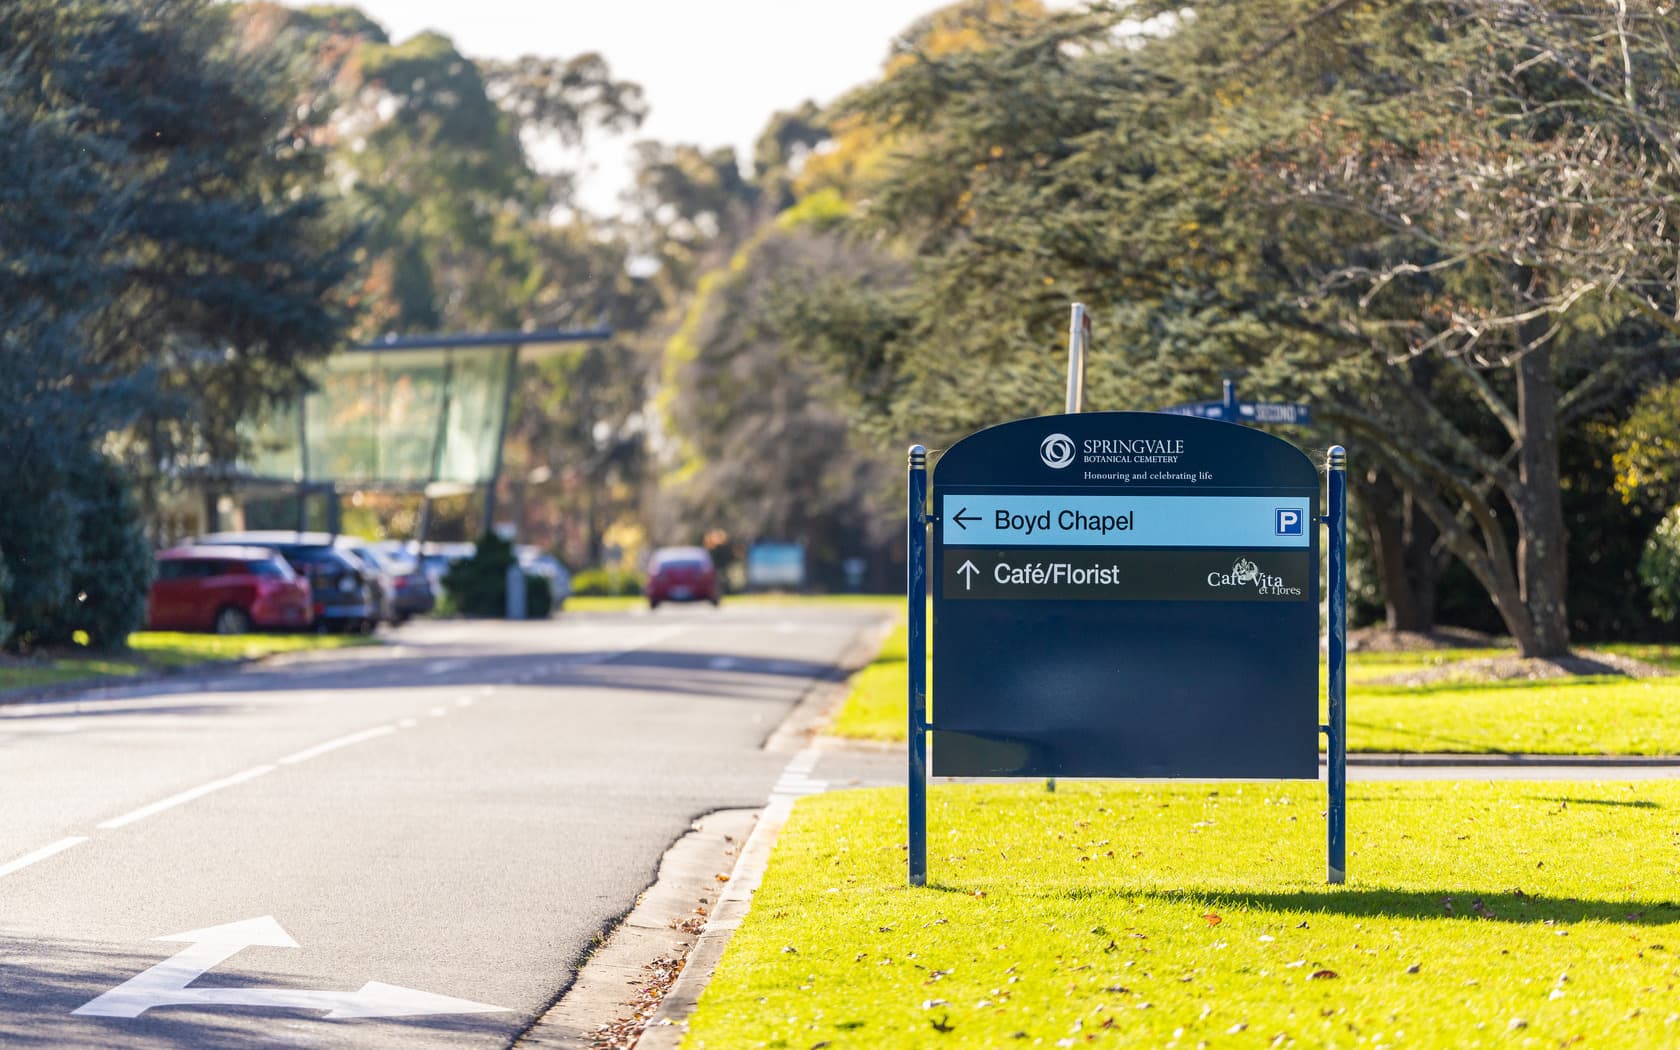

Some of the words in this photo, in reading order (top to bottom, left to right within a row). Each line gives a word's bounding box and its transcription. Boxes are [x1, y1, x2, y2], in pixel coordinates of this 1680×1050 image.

[1083, 439, 1185, 454] SPRINGVALE
[1083, 455, 1133, 464] BOTANICAL
[1133, 455, 1178, 464] CEMETERY
[1083, 471, 1131, 482] Honouring
[1132, 471, 1147, 480] and
[1149, 471, 1197, 482] celebrating
[1198, 471, 1213, 480] life
[995, 509, 1050, 536] Boyd
[1057, 509, 1134, 536] Chapel
[1280, 511, 1298, 533] P
[993, 562, 1121, 585] Café/Florist
[1252, 572, 1283, 587] Vita
[1258, 586, 1269, 595] et
[1272, 586, 1301, 595] flores
